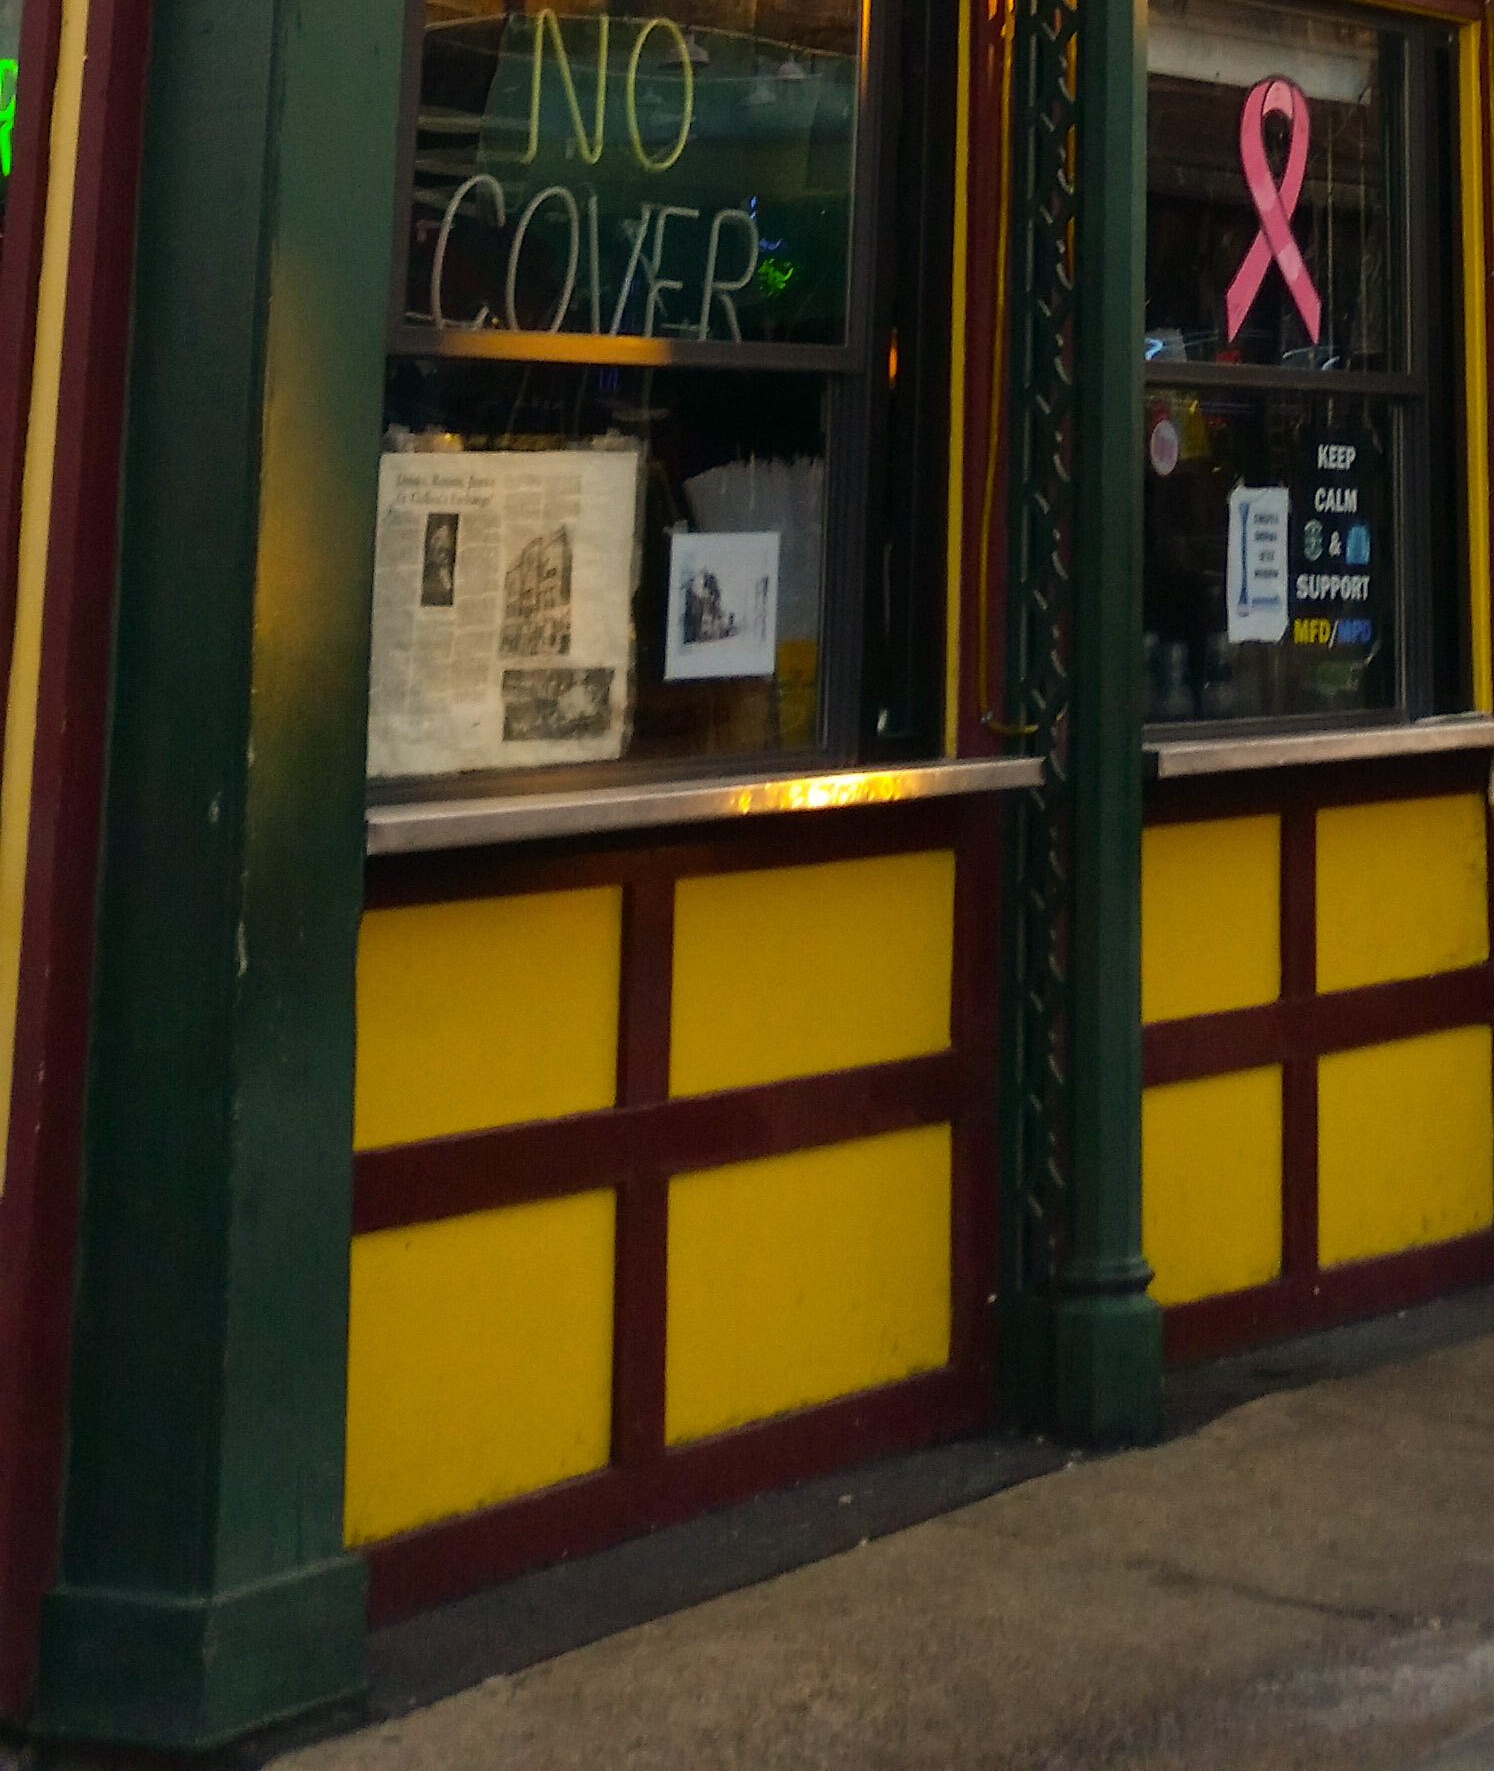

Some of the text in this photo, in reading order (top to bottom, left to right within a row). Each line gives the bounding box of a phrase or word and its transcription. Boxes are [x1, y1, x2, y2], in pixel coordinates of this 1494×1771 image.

[522, 7, 695, 172] NO
[431, 173, 761, 345] COVER
[1316, 443, 1357, 471] KEEP
[1314, 486, 1359, 514] CALM
[1295, 572, 1371, 602] SUPPORT
